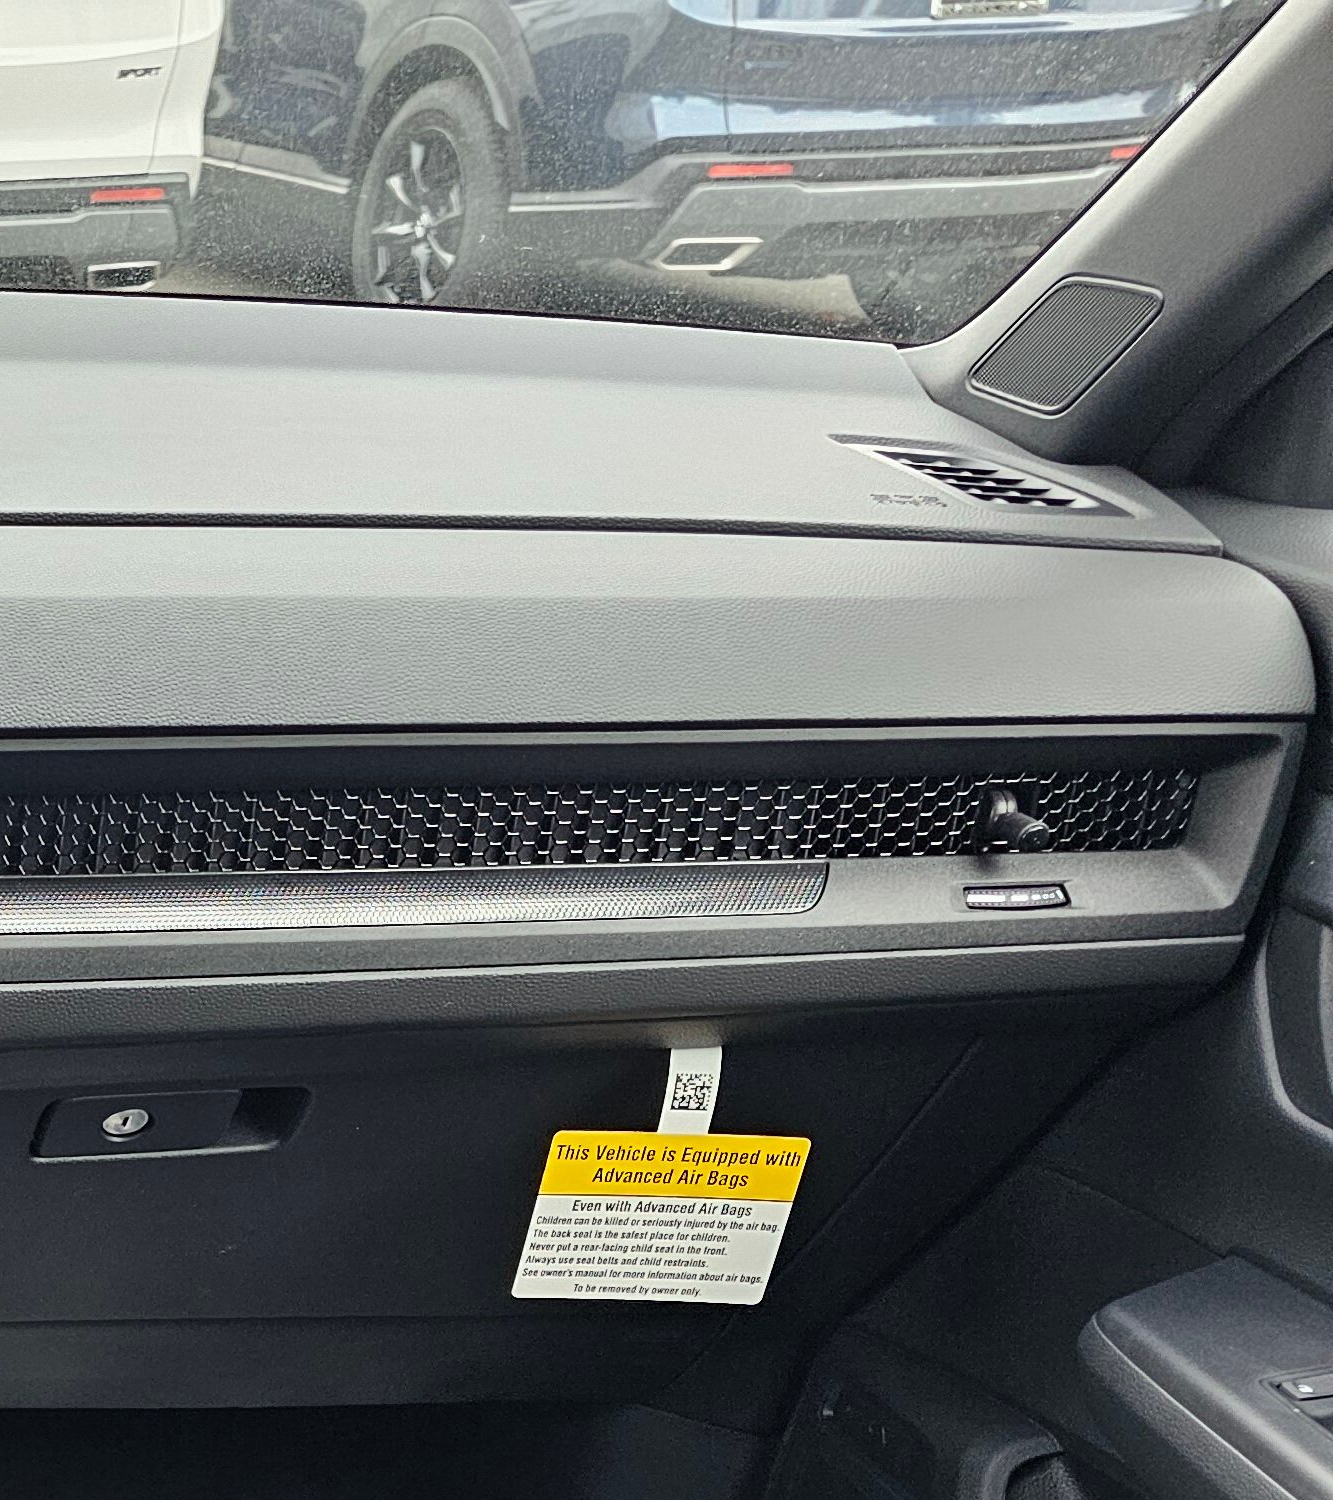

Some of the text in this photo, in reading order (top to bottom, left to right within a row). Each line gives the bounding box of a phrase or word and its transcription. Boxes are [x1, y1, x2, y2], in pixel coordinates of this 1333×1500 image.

[556, 1144, 801, 1167] This Vehicle is Equipped with
[592, 1168, 749, 1190] Advanced Air Bags
[572, 1200, 753, 1218] Even with Advanced Air Bags
[536, 1216, 572, 1225] Children
[574, 1217, 590, 1225] can
[591, 1216, 602, 1225] be
[604, 1217, 629, 1226] killed
[642, 1218, 682, 1228] seriously
[684, 1219, 715, 1229] injured
[717, 1221, 728, 1230] by
[730, 1221, 744, 1230] the
[746, 1223, 759, 1231] air
[760, 1223, 780, 1233] bag.
[533, 1229, 731, 1242] The back seat the safest place for children.
[529, 1243, 555, 1251] Never
[556, 1243, 571, 1252] put
[580, 1243, 628, 1253] rear-facing
[630, 1243, 653, 1253] child
[655, 1245, 674, 1253] seat
[687, 1245, 701, 1254] the
[525, 1256, 709, 1268] Always seat belts and child restraints.
[522, 1268, 764, 1285] See owner's manual for more information about air bags.
[574, 1283, 702, 1297] To be removed by owner only.
